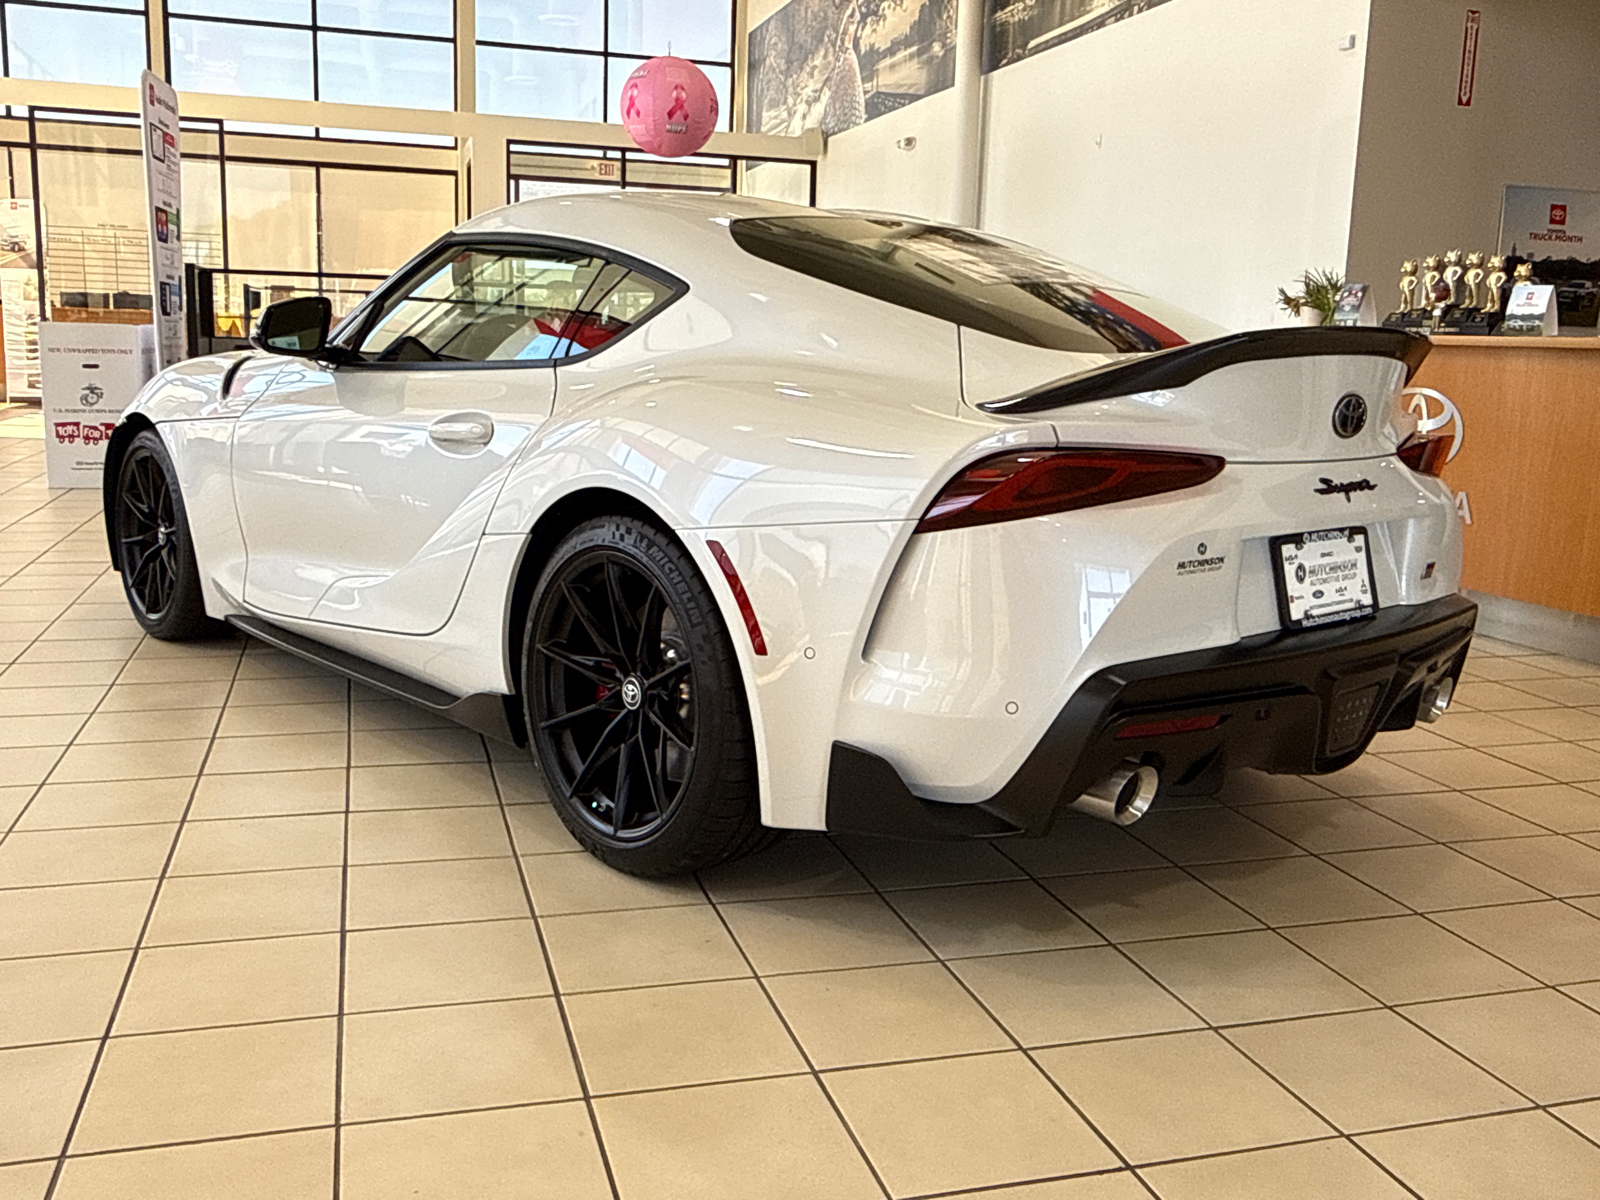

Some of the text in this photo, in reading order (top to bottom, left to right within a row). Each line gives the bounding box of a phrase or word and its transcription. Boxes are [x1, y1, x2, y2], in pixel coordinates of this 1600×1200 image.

[599, 162, 615, 176] EXIT
[1529, 232, 1583, 243] TRUCK MONTH
[63, 347, 100, 355] UNWRAPPED
[57, 424, 79, 437] TOYS
[83, 427, 101, 439] FOR
[1313, 477, 1379, 503] Supra
[1311, 529, 1350, 543] HUTCHINSON
[1176, 555, 1226, 570] HUTCHINSON
[1308, 559, 1359, 579] HUTCHINSON
[648, 545, 703, 625] MICHELIN
[1309, 572, 1358, 587] AUTOMOTIVE GROUP
